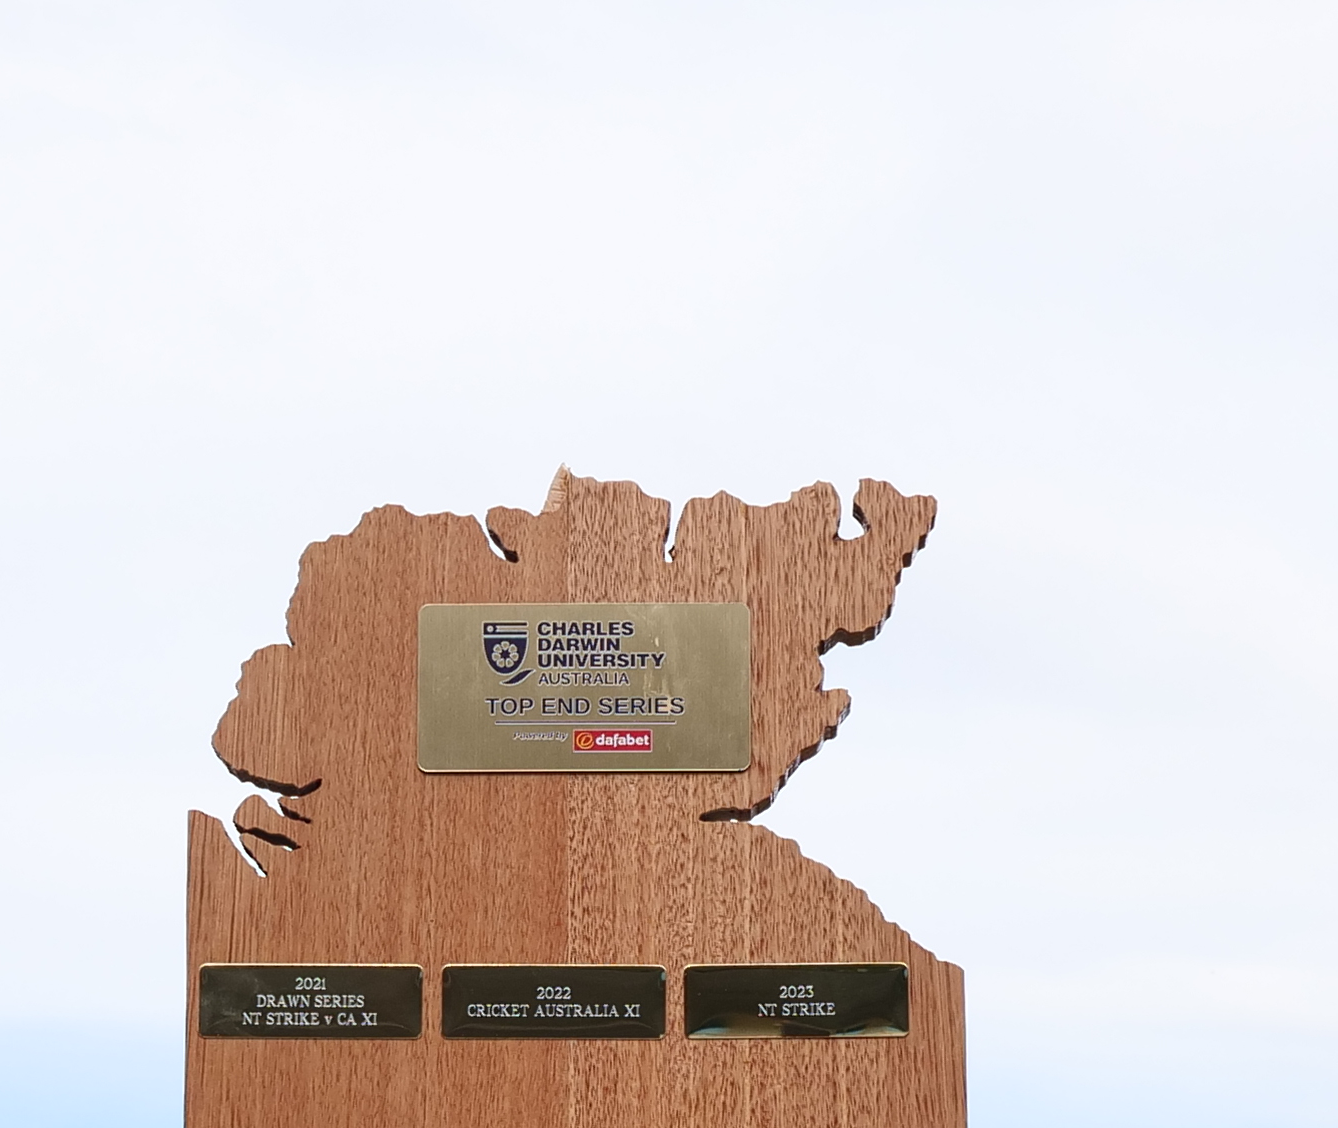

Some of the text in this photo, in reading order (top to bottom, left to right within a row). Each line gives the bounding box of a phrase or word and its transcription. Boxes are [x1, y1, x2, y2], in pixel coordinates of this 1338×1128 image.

[537, 622, 634, 636] CHARLES
[538, 638, 620, 651] DARWIN
[538, 654, 665, 668] UNIVERSITY
[538, 673, 629, 685] AUSTRALIA
[486, 698, 684, 715] TOP END SERIES
[596, 732, 650, 748] dafabet
[295, 977, 326, 990] 2021
[536, 987, 571, 1000] 2022
[779, 985, 814, 998] 2023
[256, 995, 365, 1008] DRAWN SERIES
[467, 1004, 640, 1018] CRICKET AUSTRALIA XI
[758, 1003, 836, 1017] NT STRIKE
[242, 1012, 377, 1026] NT STRIKE v CA XI
